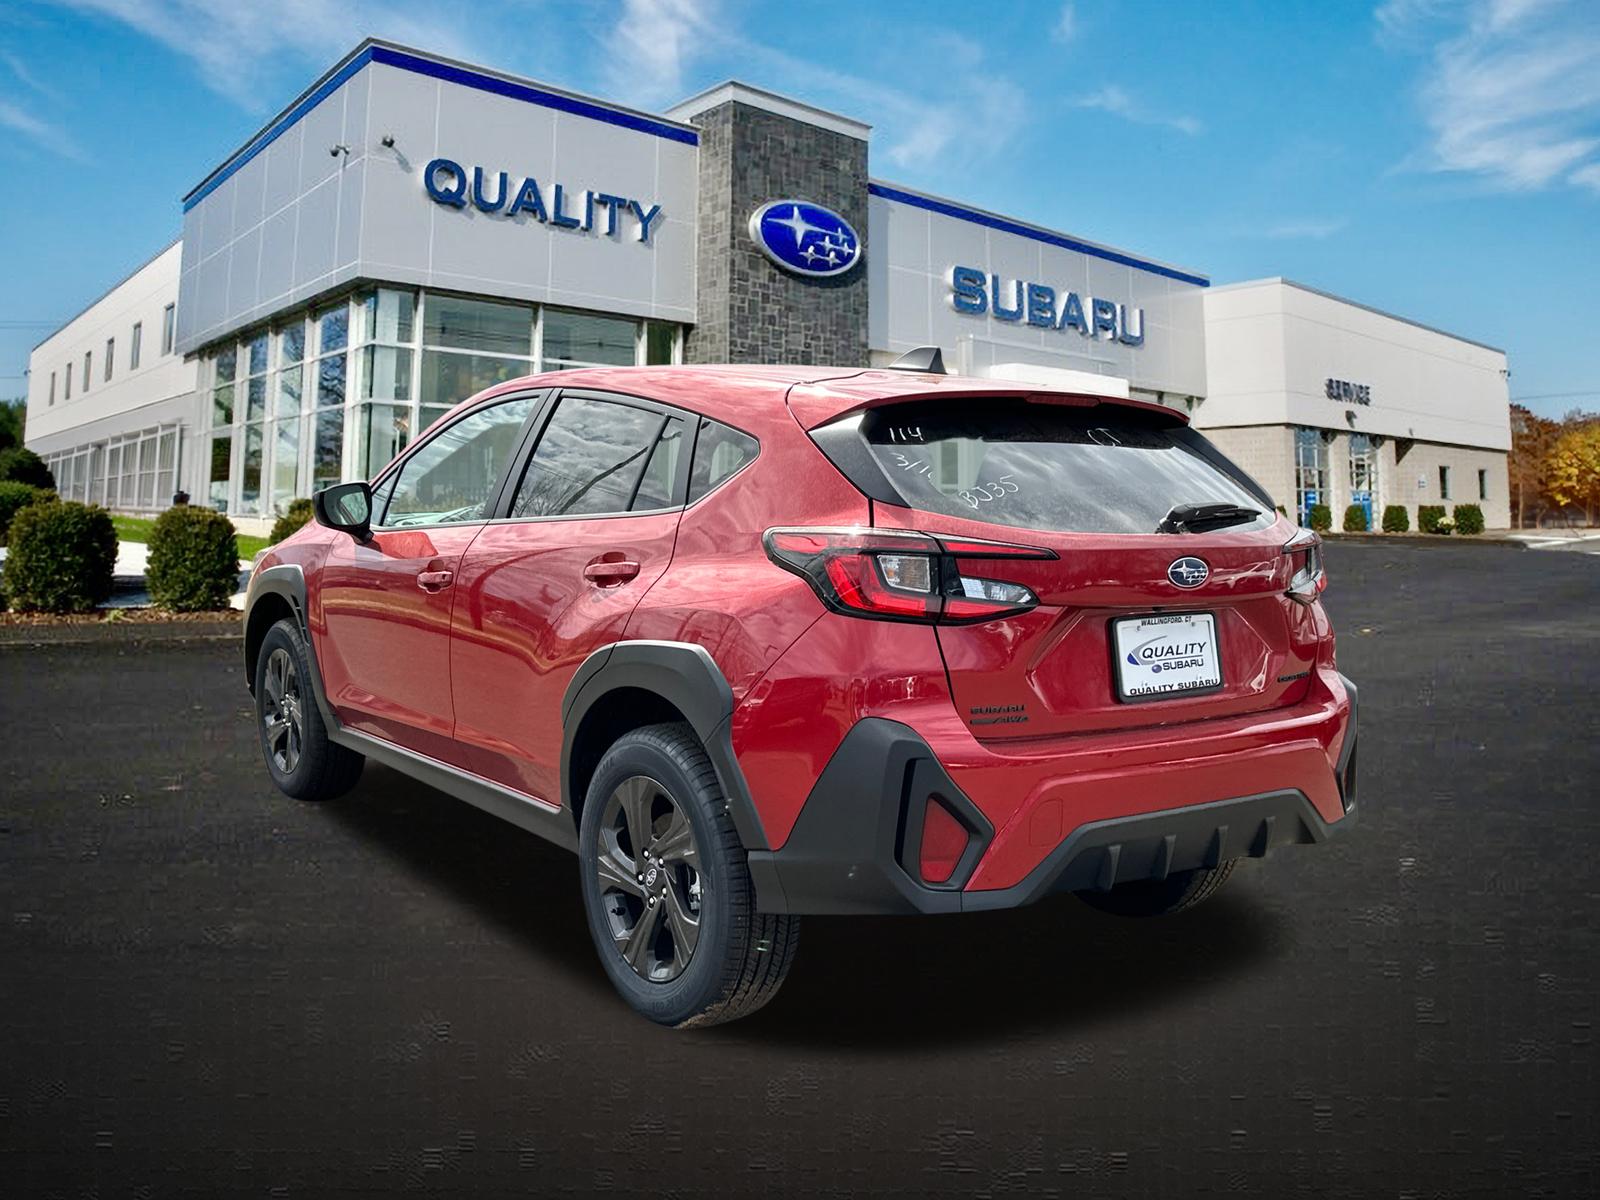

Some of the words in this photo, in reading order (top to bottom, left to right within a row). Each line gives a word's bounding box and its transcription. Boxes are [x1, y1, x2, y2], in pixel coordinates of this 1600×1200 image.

[423, 158, 662, 243] QUALITY
[950, 265, 1145, 347] SUBARU
[1326, 378, 1371, 406] SERVICE
[1185, 615, 1192, 623] CT
[1142, 642, 1207, 659] QUALITY
[1162, 658, 1204, 671] SUBARU
[1129, 683, 1175, 695] QUALITY
[1177, 678, 1218, 690] SUBARU
